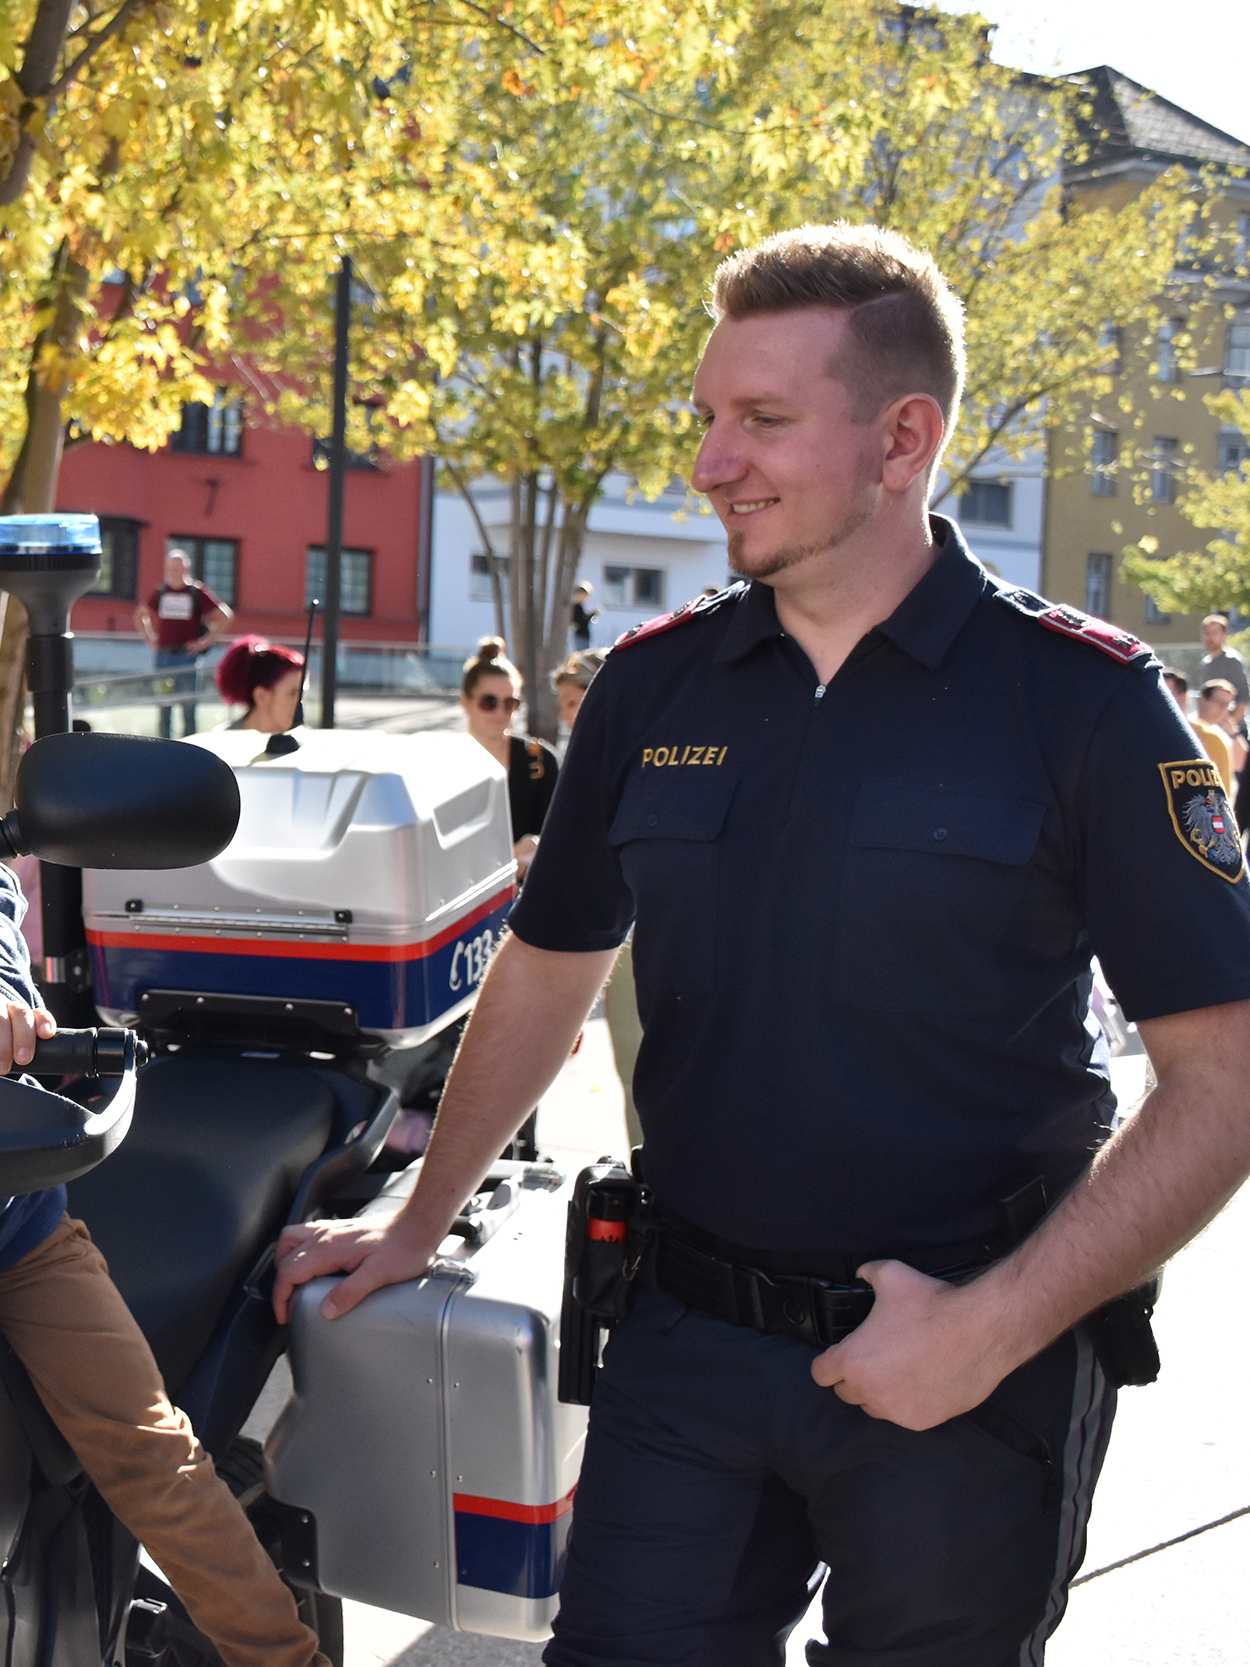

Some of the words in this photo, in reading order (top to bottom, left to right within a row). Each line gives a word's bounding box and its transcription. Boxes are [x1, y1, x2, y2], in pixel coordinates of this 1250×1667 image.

[642, 745, 728, 769] POLIZEI
[1170, 768, 1222, 789] POLIZ
[464, 929, 493, 986] 133
